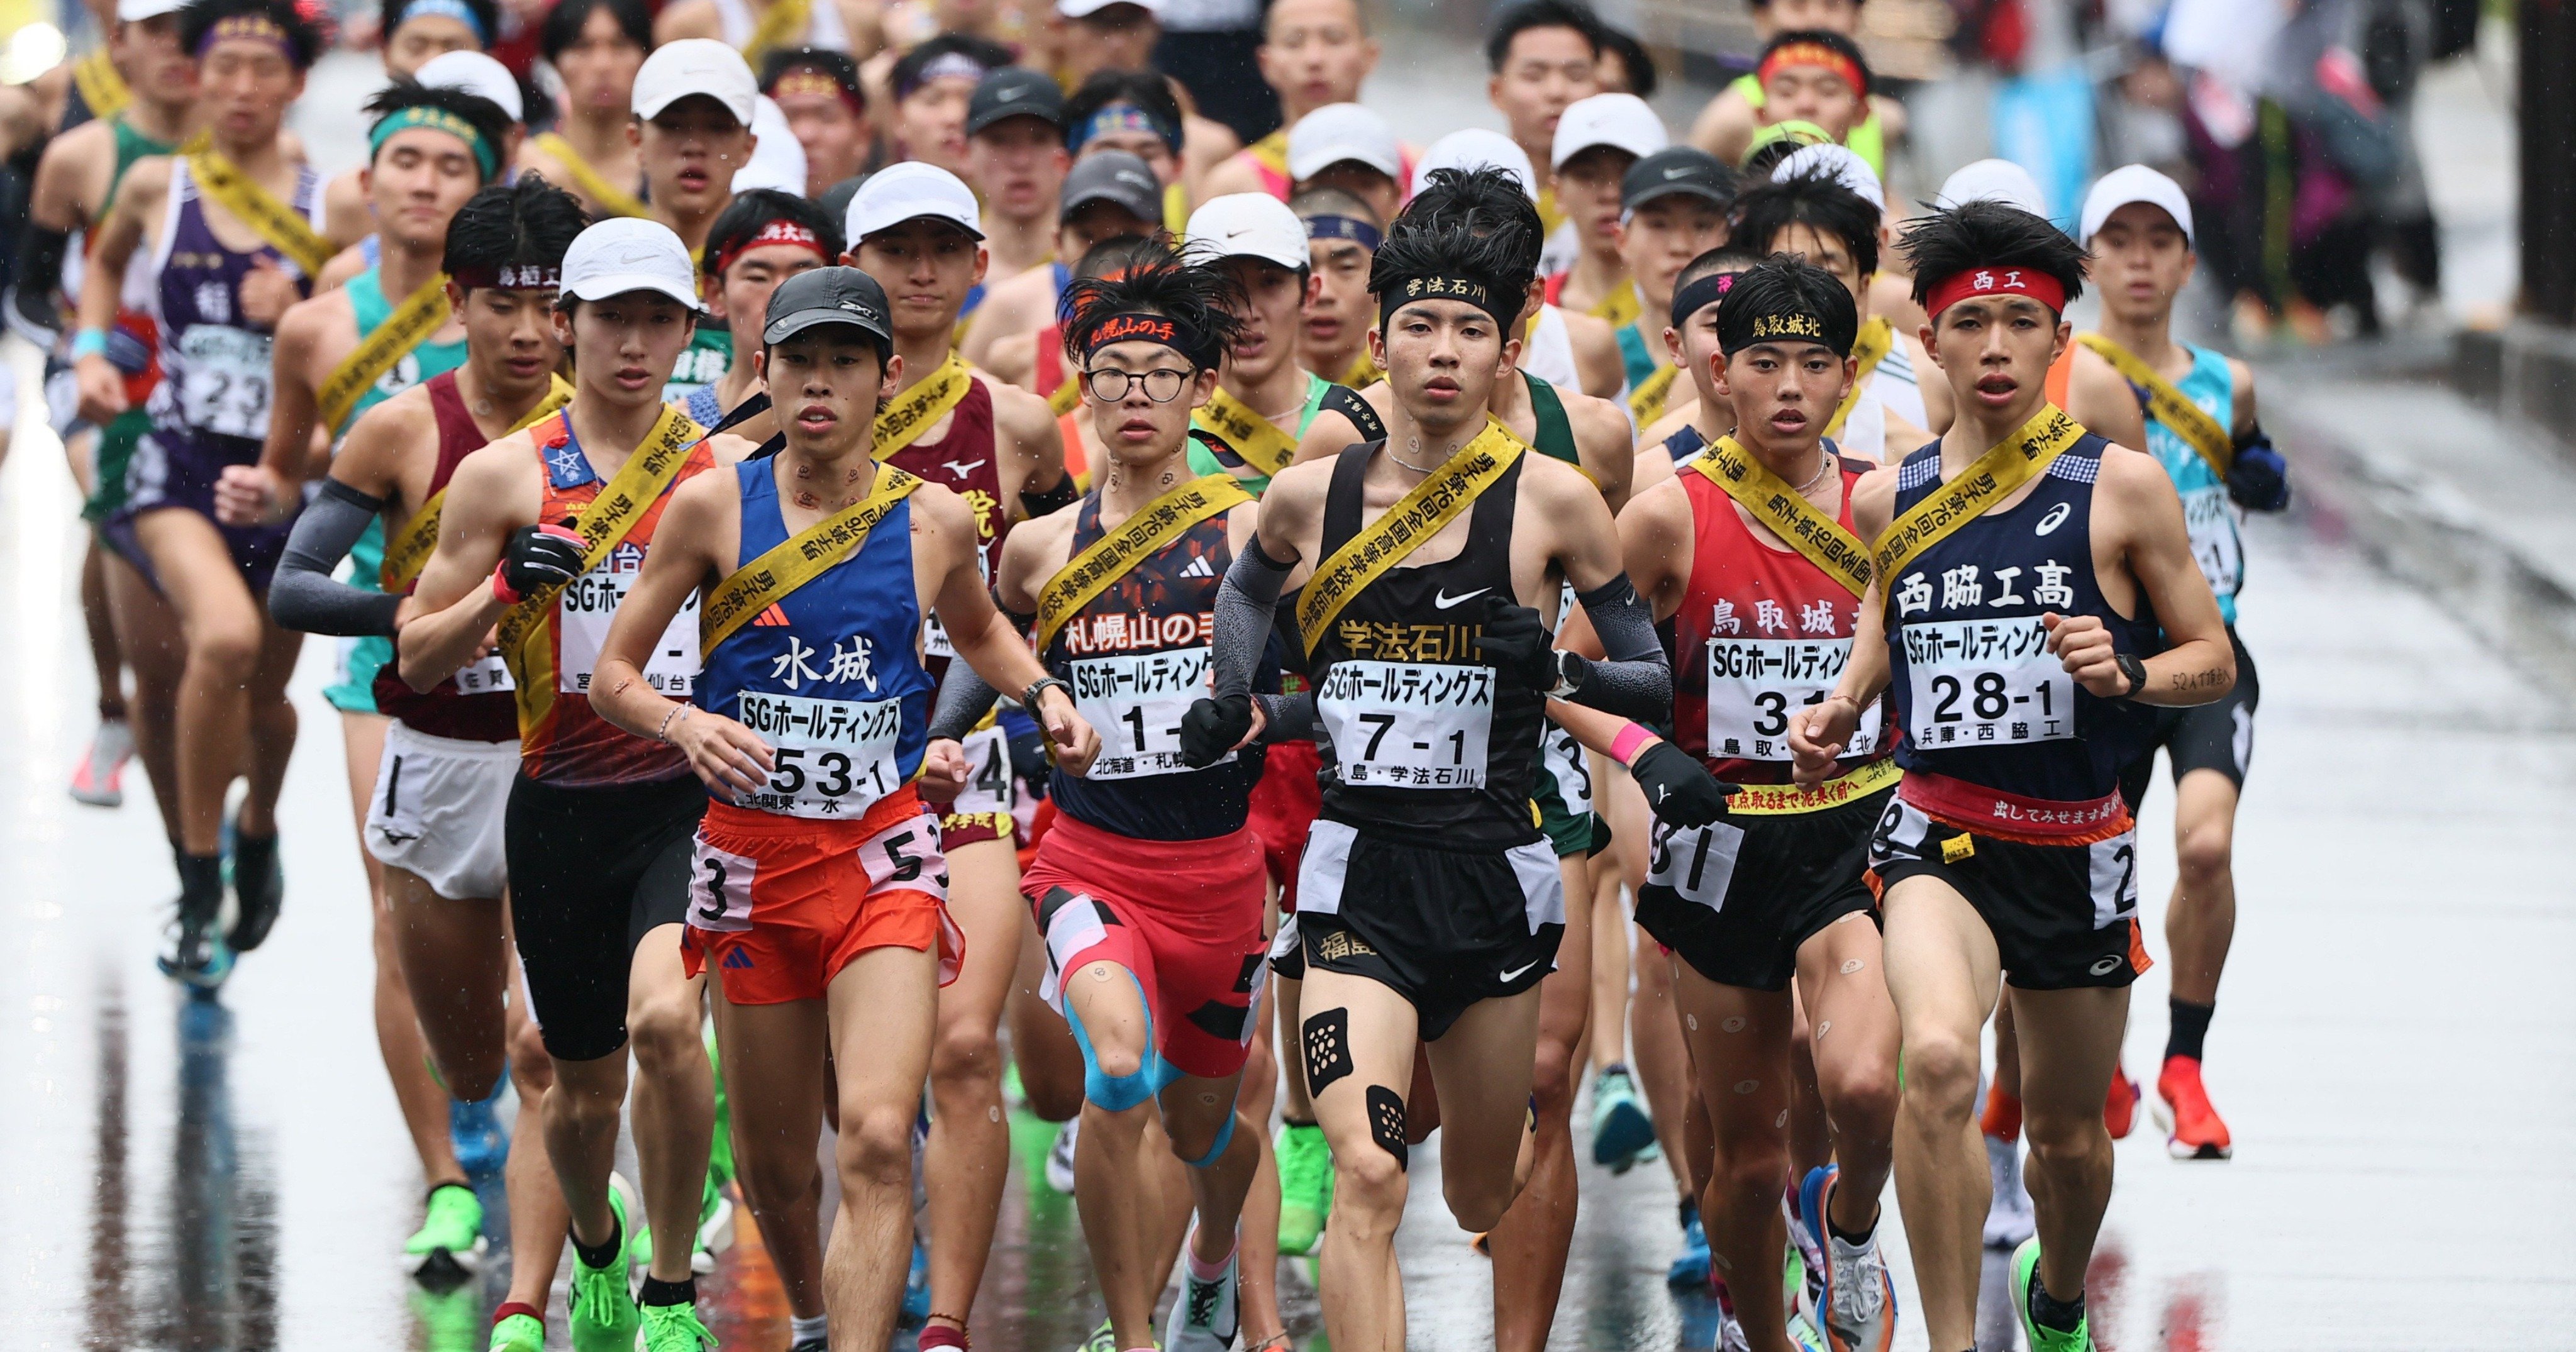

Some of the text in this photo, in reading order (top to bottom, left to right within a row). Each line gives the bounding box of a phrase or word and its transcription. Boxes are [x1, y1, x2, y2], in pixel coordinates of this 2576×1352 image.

[1406, 277, 1486, 304] 学法石川
[1973, 270, 2026, 290] 西工
[1752, 313, 1821, 338] 鳥取城北
[2021, 411, 2074, 461] 男子第76
[1767, 493, 1873, 587] 男子第76回全国
[769, 635, 878, 693] 水城
[1340, 619, 1482, 662] 学法石川
[1713, 643, 1853, 680] SGホールディン
[1323, 667, 1490, 706] SGホールディングス
[1931, 672, 2051, 723] 28-1
[744, 697, 901, 744] SGホールディングス
[1358, 714, 1465, 764] 7-1
[771, 748, 886, 797] 53-1
[2113, 845, 2136, 914] 2
